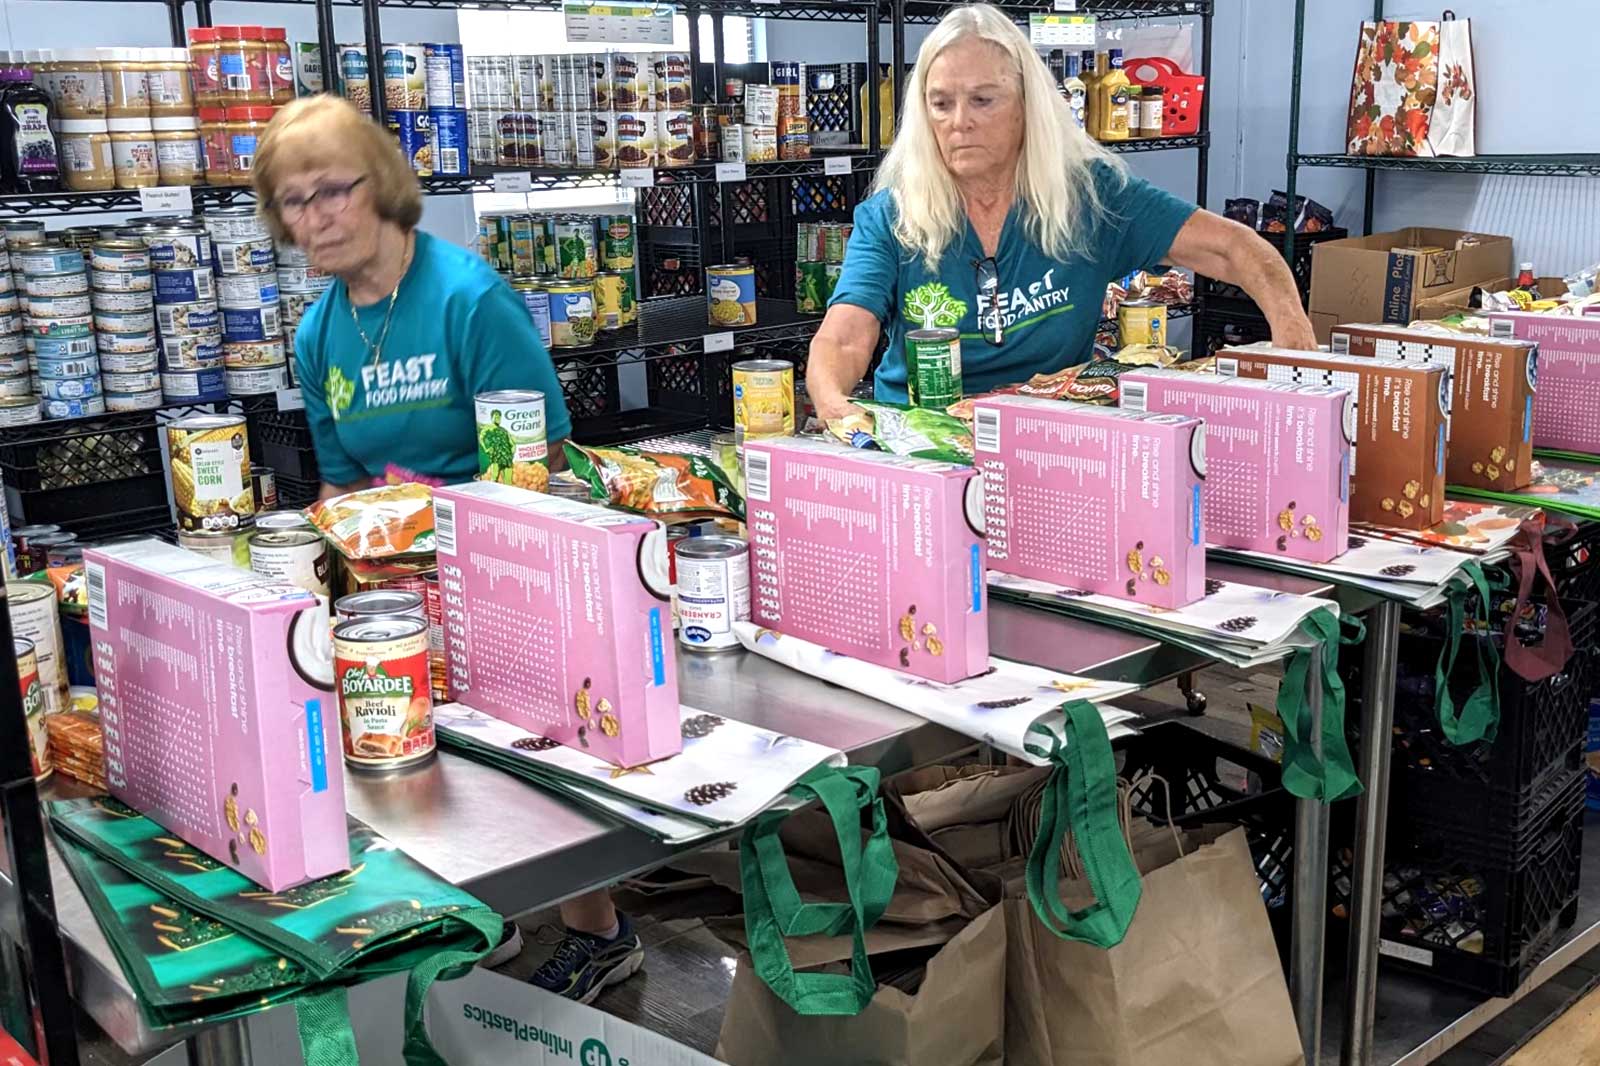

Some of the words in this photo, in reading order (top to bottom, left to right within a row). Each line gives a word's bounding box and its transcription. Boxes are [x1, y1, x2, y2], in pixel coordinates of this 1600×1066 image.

[776, 68, 798, 77] GIRL
[976, 269, 1054, 315] FEAST
[1388, 286, 1400, 320] Inline
[977, 314, 1016, 331] FOOD
[1017, 287, 1070, 320] PANTRY
[361, 354, 436, 392] FEAST
[1483, 364, 1492, 401] breakfast
[366, 386, 398, 409] FOOD
[400, 376, 449, 402] PANTRY
[1404, 378, 1412, 396] Rise
[504, 409, 540, 420] Green
[1308, 408, 1317, 425] Rise
[1392, 391, 1401, 432] breakfast
[1403, 397, 1411, 416] and
[510, 420, 542, 432] Giant
[1307, 427, 1315, 447] and
[1402, 416, 1410, 439] shine
[1153, 437, 1161, 457] Rise
[1296, 421, 1304, 464] breakfast
[197, 466, 219, 474] SWEET
[1152, 459, 1160, 481] and
[1306, 448, 1315, 472] shine
[198, 475, 222, 486] CORN
[1141, 452, 1150, 499] breakfast
[924, 488, 933, 510] Rise
[1152, 482, 1160, 508] shine
[913, 503, 923, 557] breakfast
[924, 512, 933, 537] and
[591, 544, 599, 570] Rise
[925, 538, 933, 567] shine
[582, 562, 595, 622] breakfast
[593, 572, 602, 602] and
[596, 602, 604, 636] shine
[235, 625, 244, 655] Rise
[227, 645, 239, 719] breakfast
[238, 658, 247, 690] and
[342, 676, 412, 694] BOYARDEE
[346, 668, 364, 680] Chef
[239, 694, 249, 735] shine
[355, 706, 396, 718] Ravioli
[366, 700, 384, 708] Beef
[464, 1004, 572, 1058] InlinePlastics
